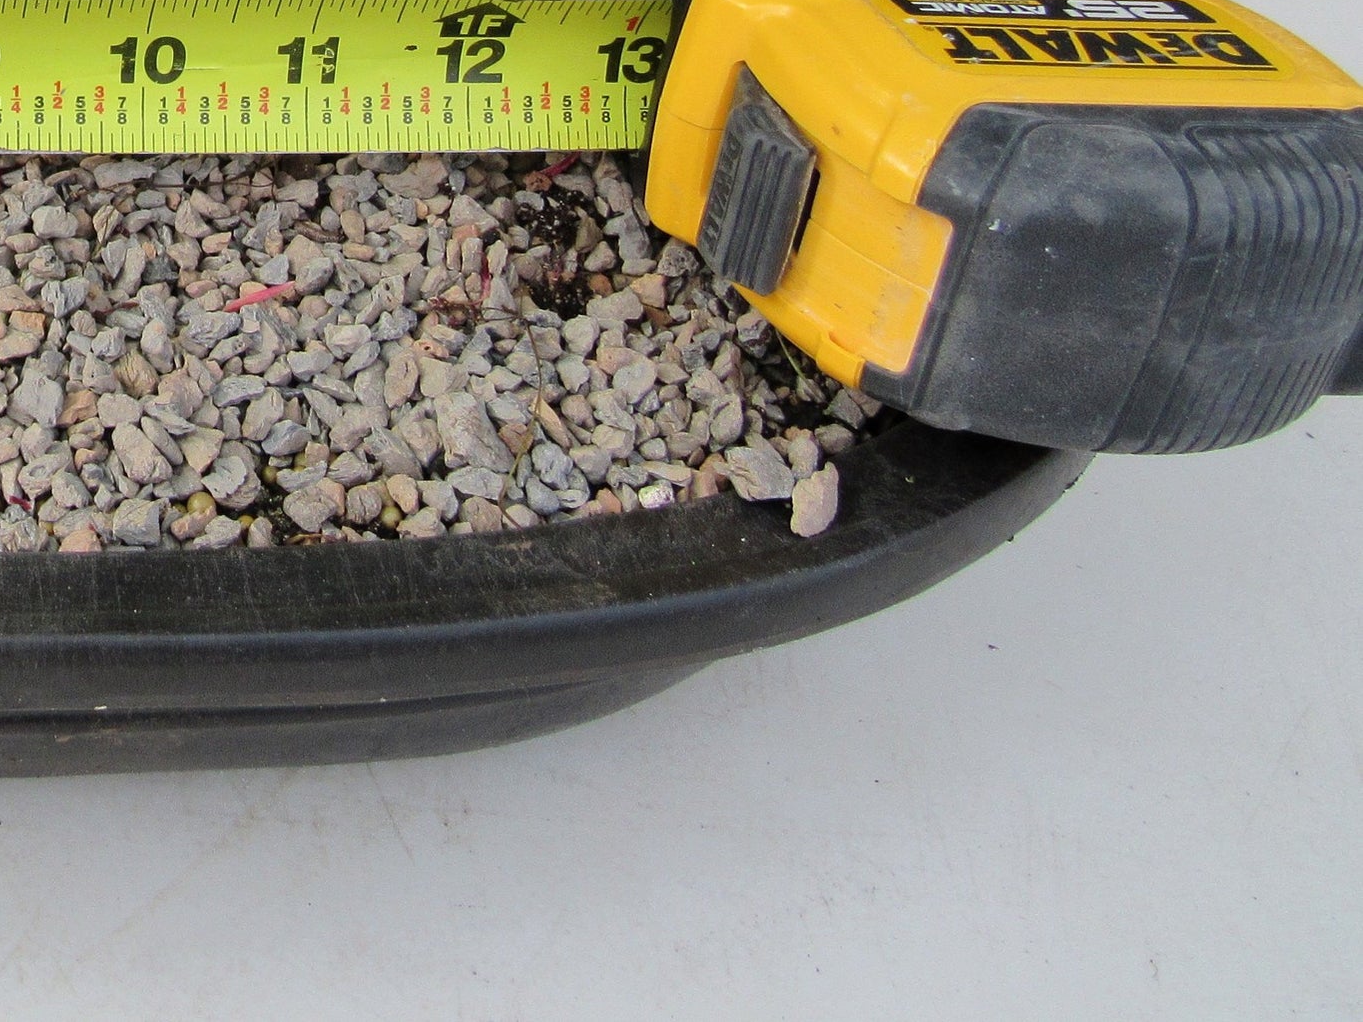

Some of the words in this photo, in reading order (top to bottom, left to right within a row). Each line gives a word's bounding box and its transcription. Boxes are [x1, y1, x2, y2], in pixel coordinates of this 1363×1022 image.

[910, 0, 1048, 16] ATOMIC
[110, 36, 186, 84] 10
[277, 36, 340, 84] 11
[436, 39, 506, 83] 12
[597, 36, 667, 83] 13
[934, 26, 1274, 66] DEWALT
